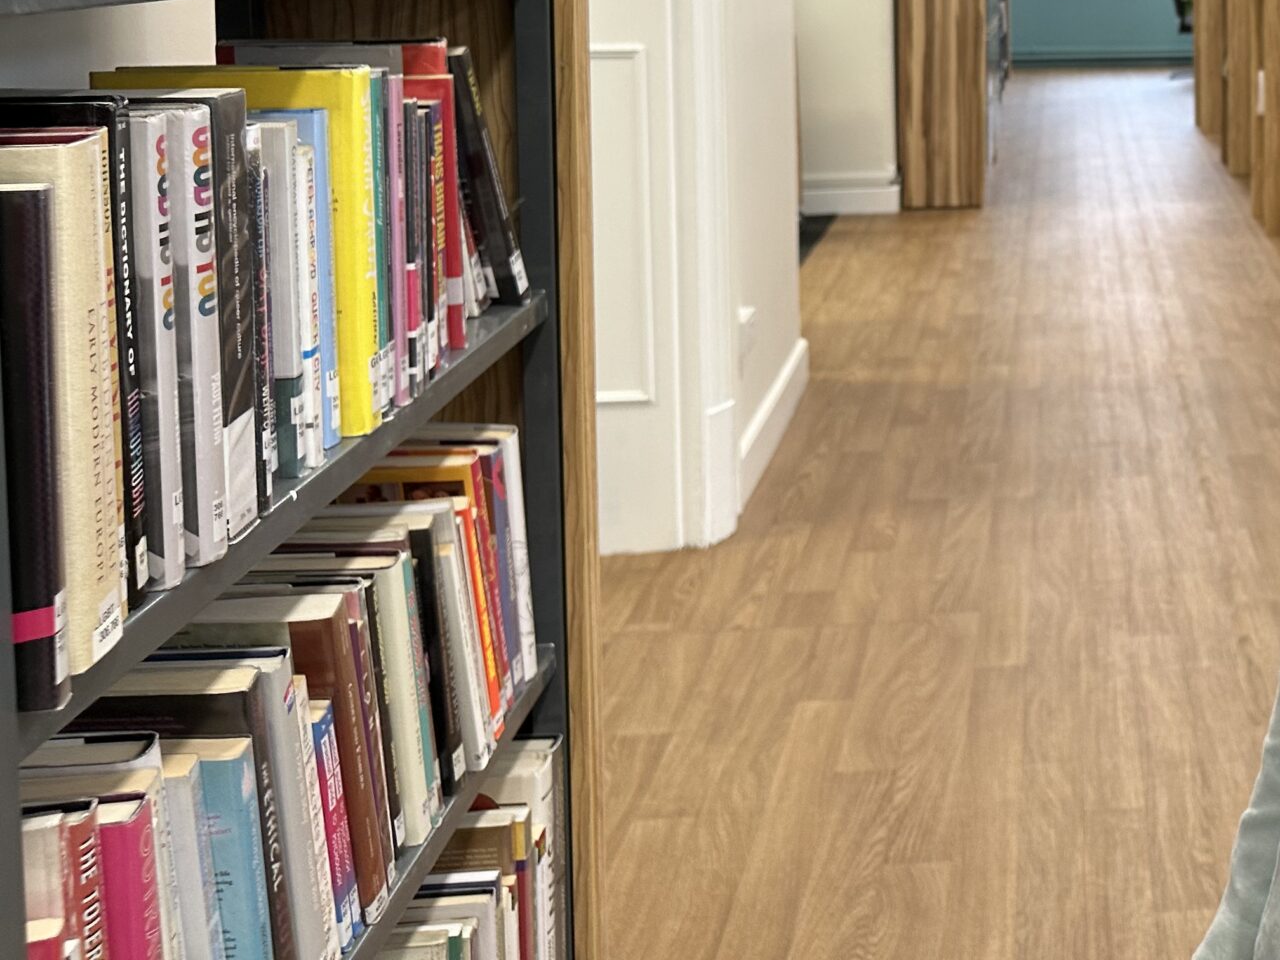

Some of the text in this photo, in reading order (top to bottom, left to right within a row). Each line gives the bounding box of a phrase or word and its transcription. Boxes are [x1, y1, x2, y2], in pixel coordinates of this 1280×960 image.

[433, 120, 446, 251] TRANS BRITAIN
[118, 147, 146, 519] THE DICTIONARY OF HOMOPHOBIA
[87, 308, 105, 585] EARLY MODERN EUROPE
[79, 835, 99, 885] THE
[263, 788, 283, 892] ETHICAL
